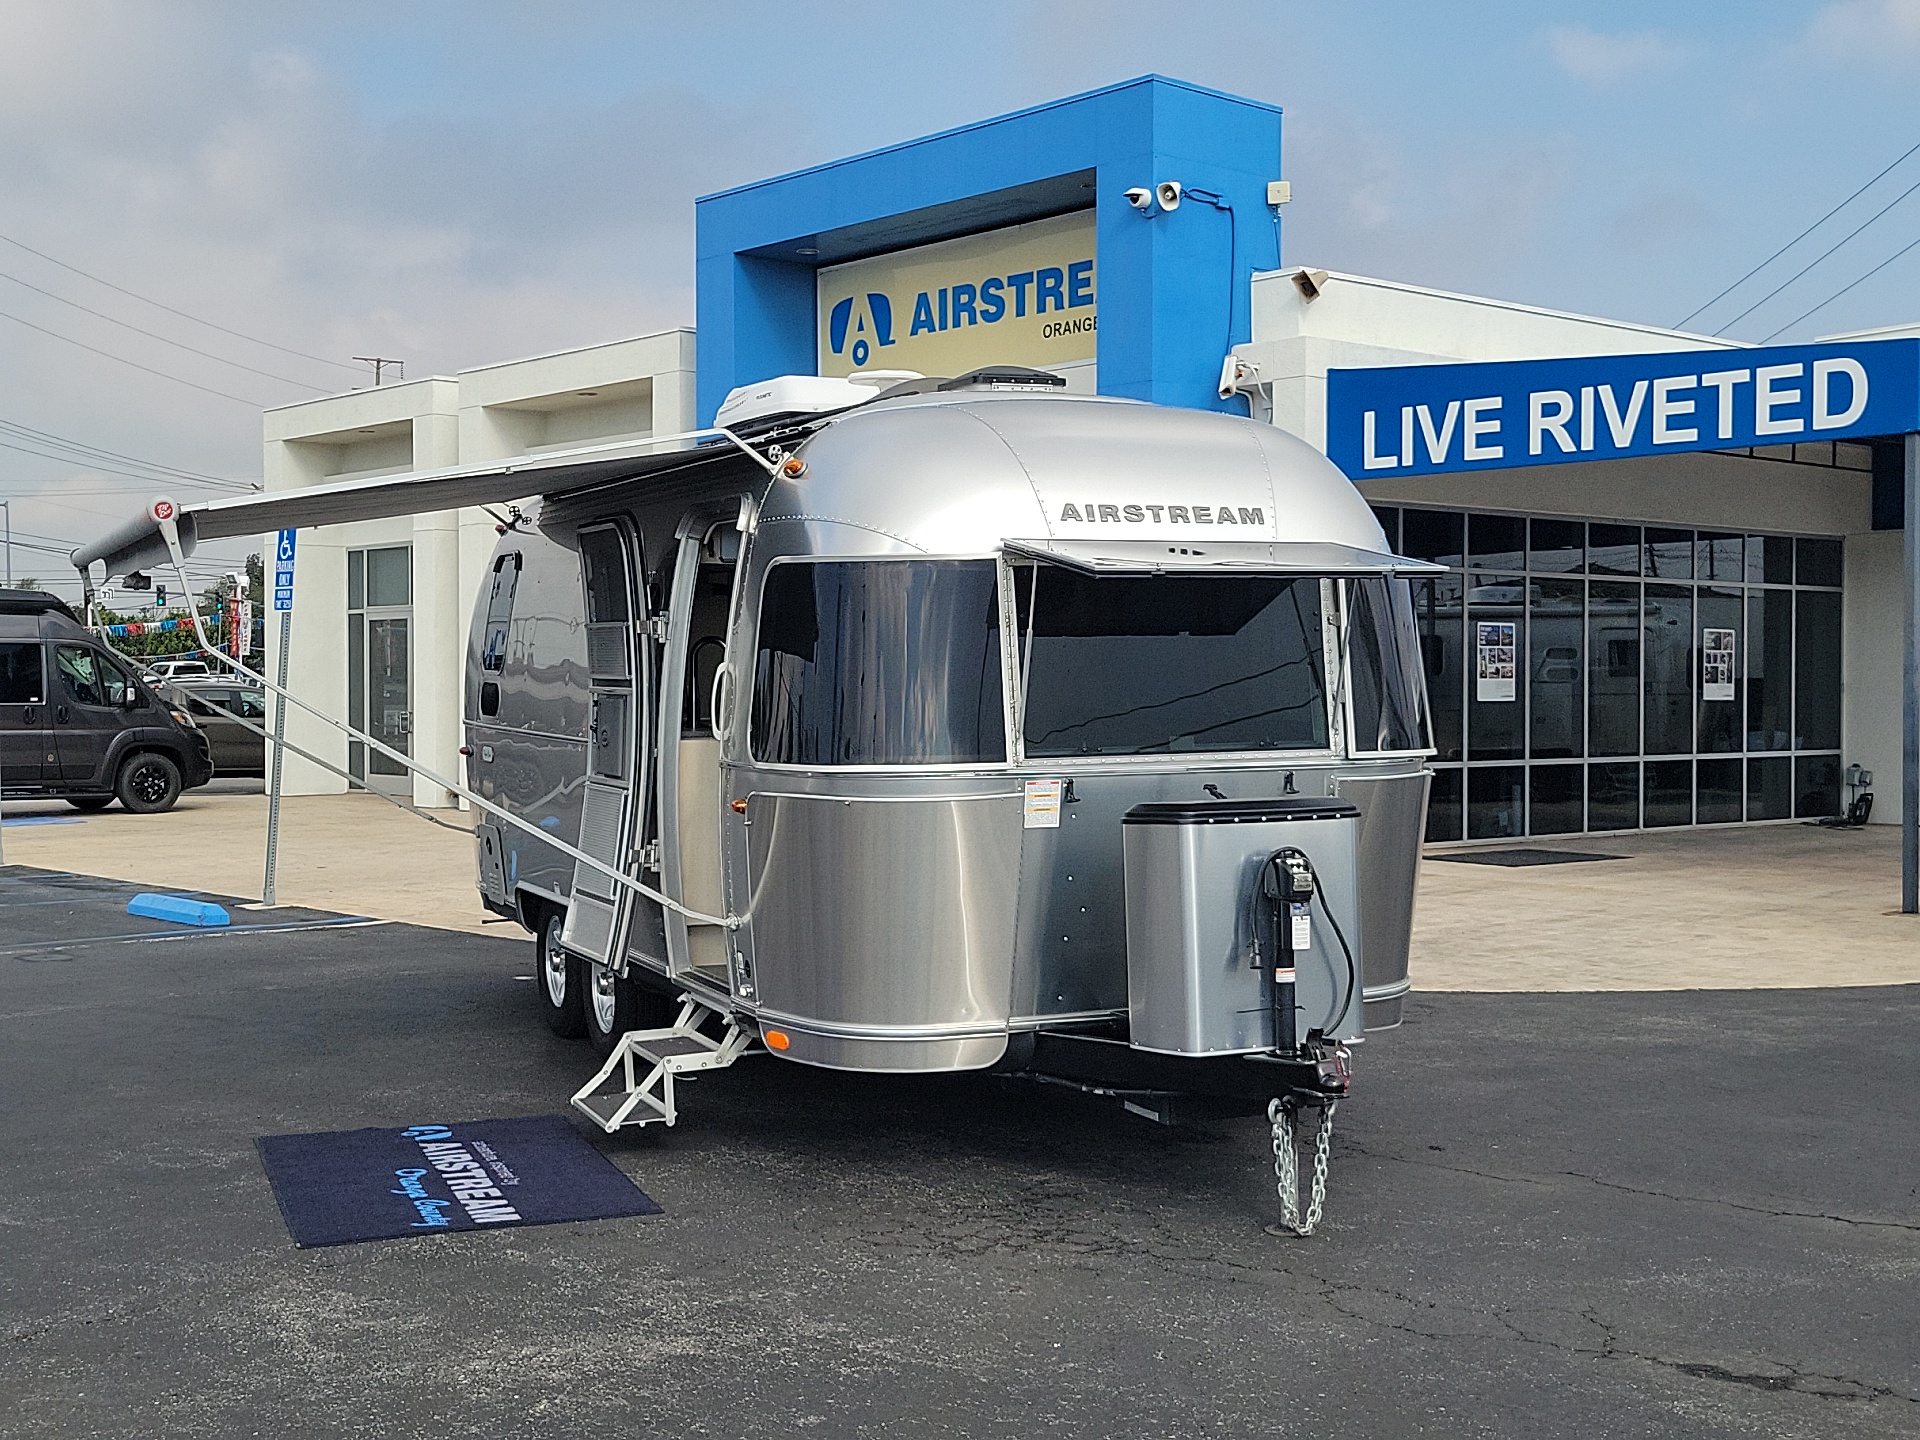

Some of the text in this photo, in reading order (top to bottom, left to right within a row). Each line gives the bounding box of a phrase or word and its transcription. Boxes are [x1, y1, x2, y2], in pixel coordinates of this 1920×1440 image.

[910, 259, 1097, 337] AIRSTRE
[1363, 357, 1869, 471] LIVE RIVETED
[1060, 503, 1265, 525] AIRSTREAM
[418, 1142, 522, 1223] AIRSTREAM
